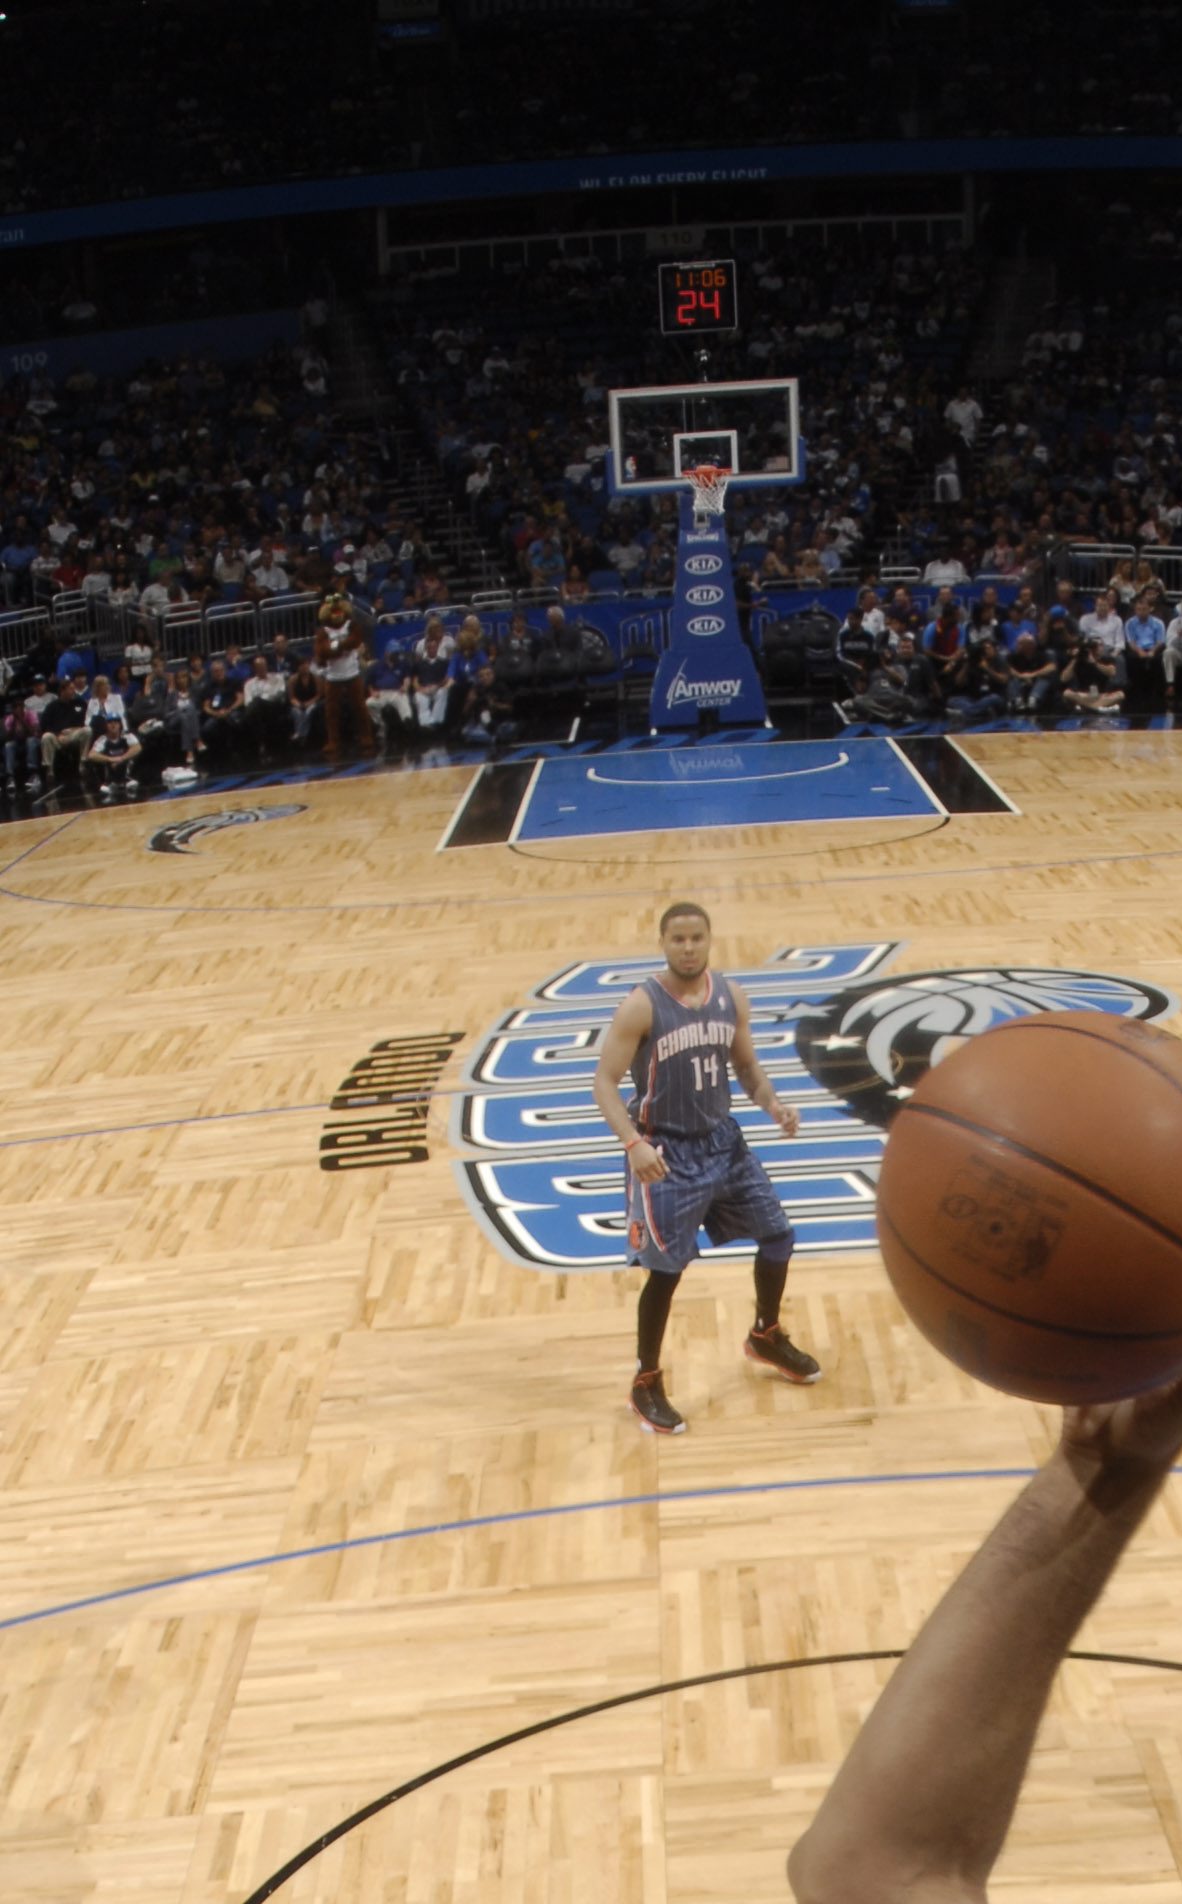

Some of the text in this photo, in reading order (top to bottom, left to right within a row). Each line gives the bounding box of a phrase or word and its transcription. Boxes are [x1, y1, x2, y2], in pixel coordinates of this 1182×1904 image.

[674, 267, 729, 288] 11:06
[676, 289, 722, 325] 24
[10, 351, 49, 374] 109
[689, 557, 719, 572] KIA
[690, 588, 720, 603] KIA
[691, 618, 721, 633] KIA
[672, 675, 742, 701] Amway
[695, 697, 732, 709] CENTER
[690, 1053, 719, 1092] 14
[318, 1030, 468, 1172] ORLANDO
